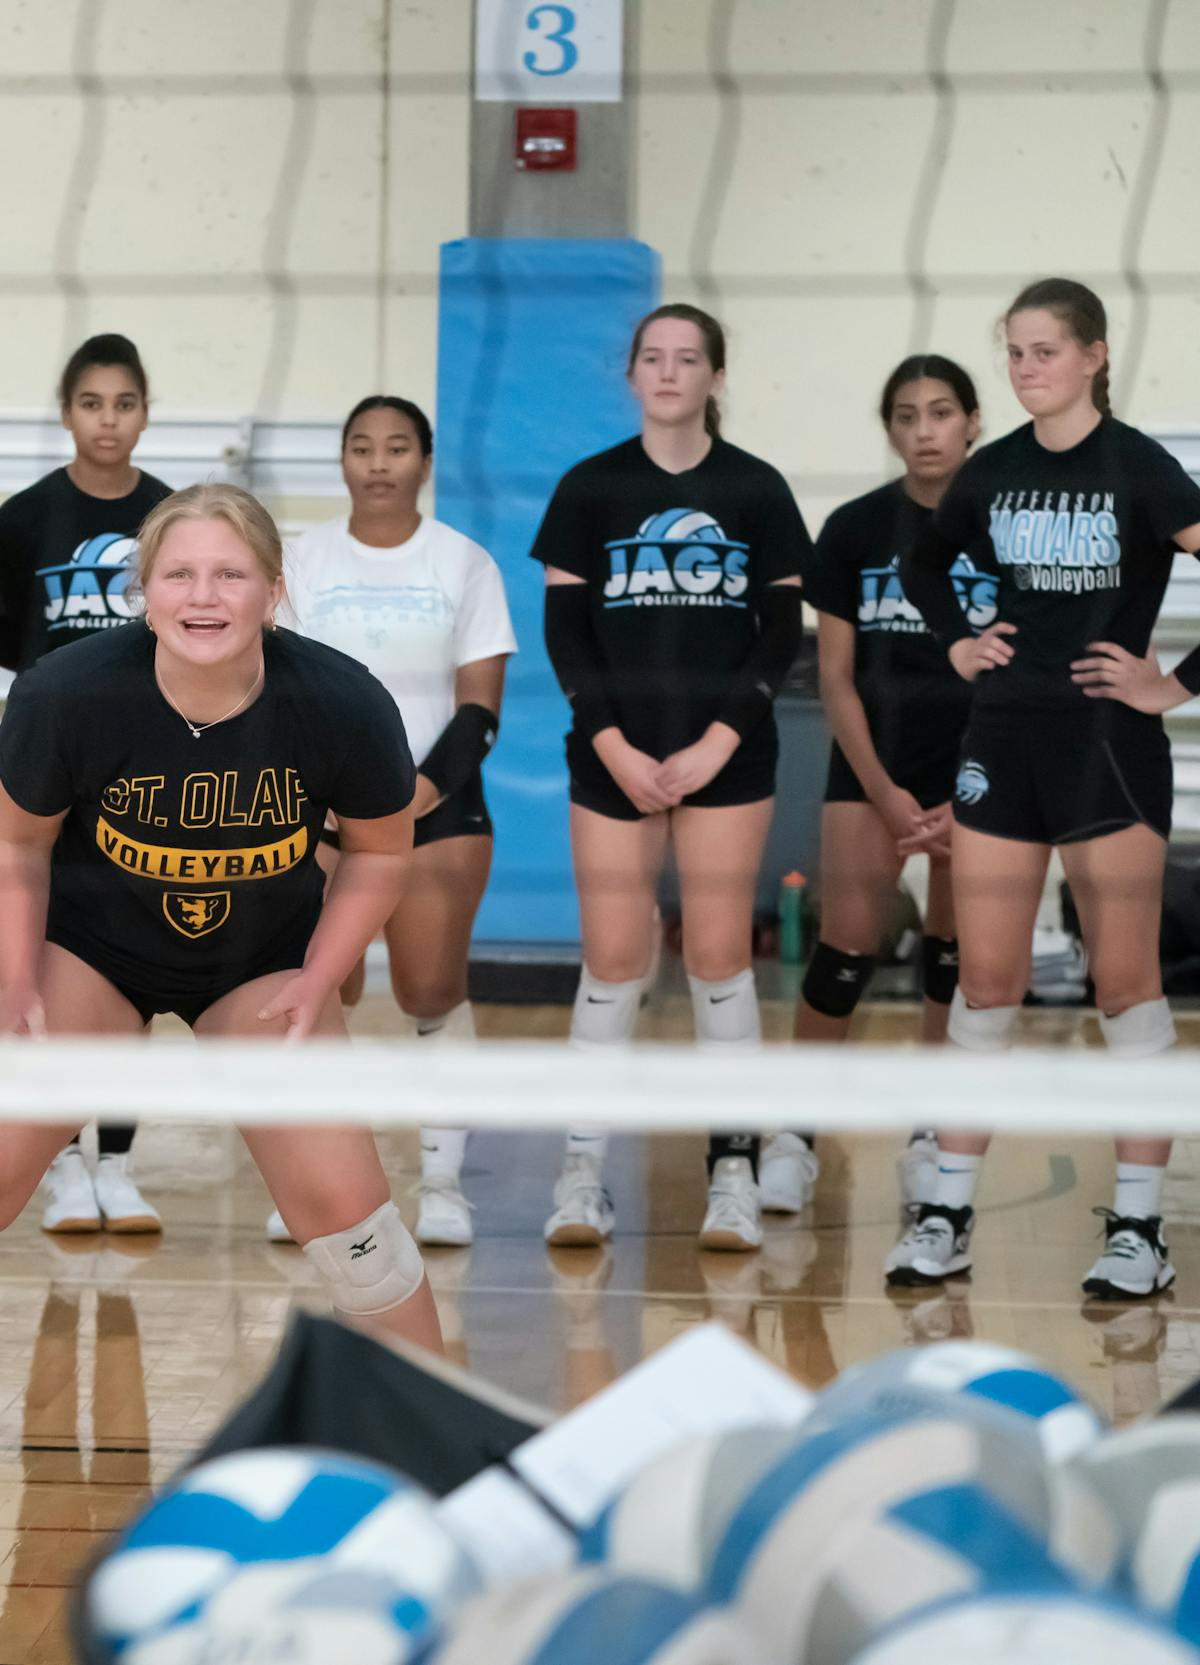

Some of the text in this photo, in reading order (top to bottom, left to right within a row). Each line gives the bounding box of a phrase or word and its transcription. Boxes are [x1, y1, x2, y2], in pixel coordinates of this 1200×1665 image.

[523, 4, 579, 76] 3
[990, 491, 1115, 512] JEFFERSON
[603, 545, 749, 598] JAGS
[1031, 565, 1121, 595] Volleyball
[633, 594, 724, 607] VOLLEYBALL
[858, 575, 998, 627] JAS
[100, 776, 169, 828] ST.
[103, 828, 301, 878] VOLLEYBALL
